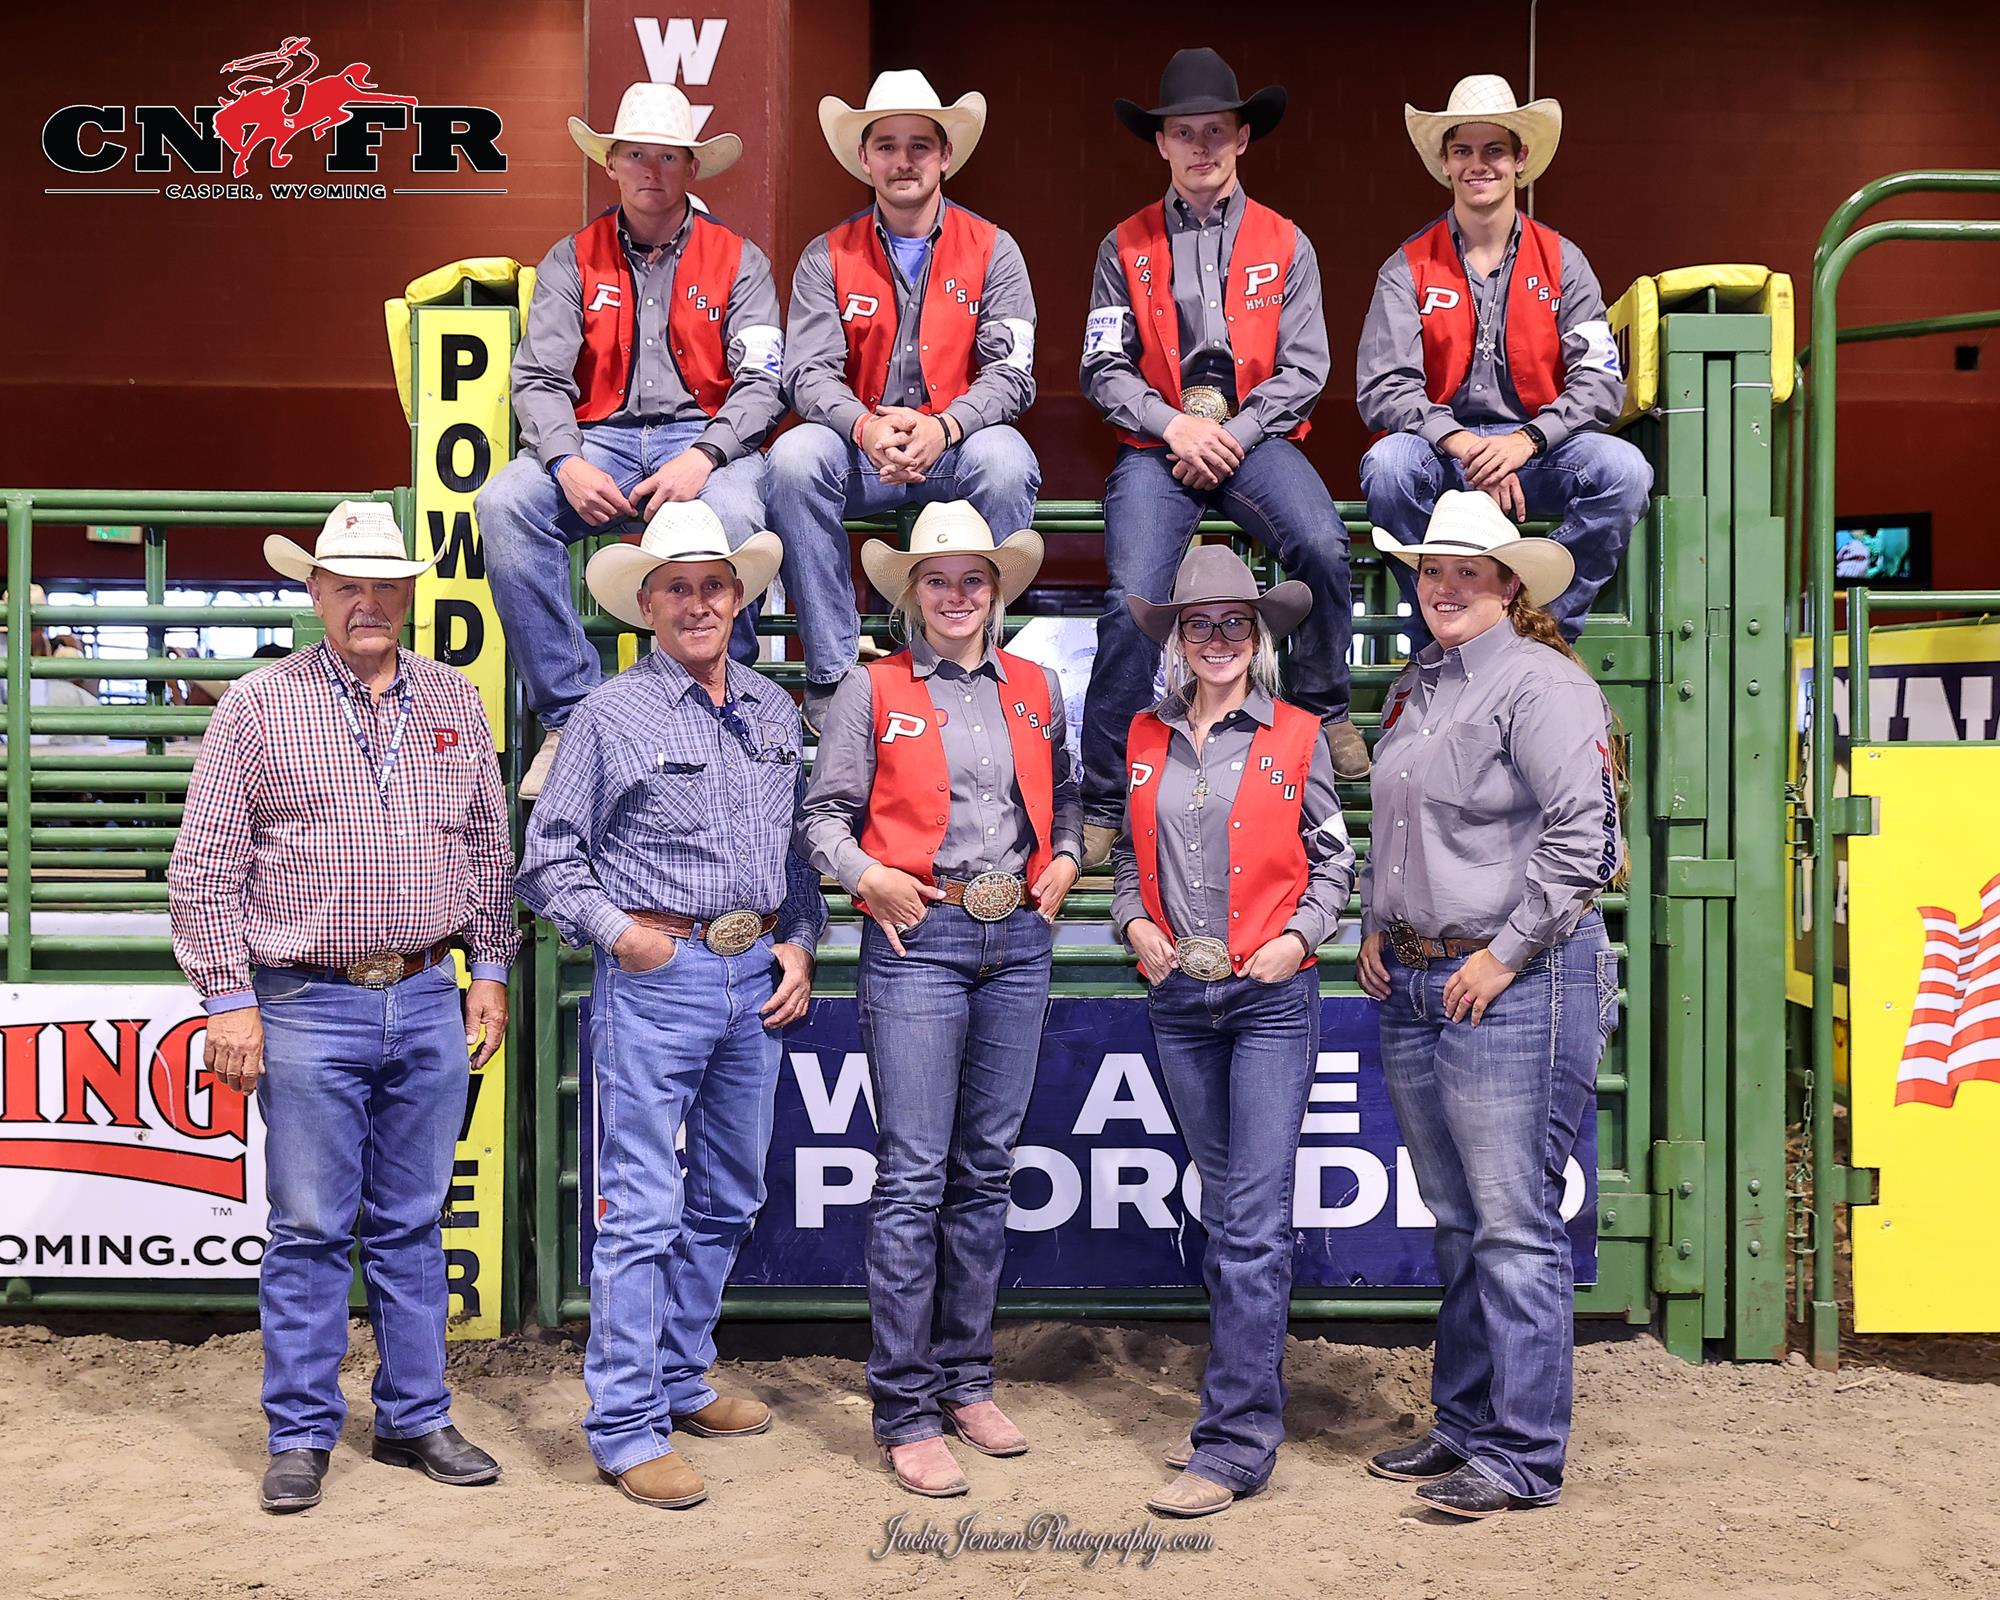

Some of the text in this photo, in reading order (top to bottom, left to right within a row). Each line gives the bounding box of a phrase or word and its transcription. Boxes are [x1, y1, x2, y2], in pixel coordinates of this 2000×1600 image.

[1244, 262, 1279, 296] P
[687, 284, 720, 321] PSU
[841, 293, 879, 322] P
[945, 279, 980, 316] PSU
[1419, 286, 1460, 315] P
[764, 353, 781, 376] 2
[427, 334, 490, 668] POWD
[319, 649, 337, 680] CINCH
[340, 697, 363, 735] CINCH
[391, 713, 409, 749] CINCH
[880, 711, 927, 744] P
[432, 728, 459, 753] P
[1259, 756, 1297, 800] PSU
[789, 1052, 1360, 1134] W AE
[211, 1207, 232, 1216] TM
